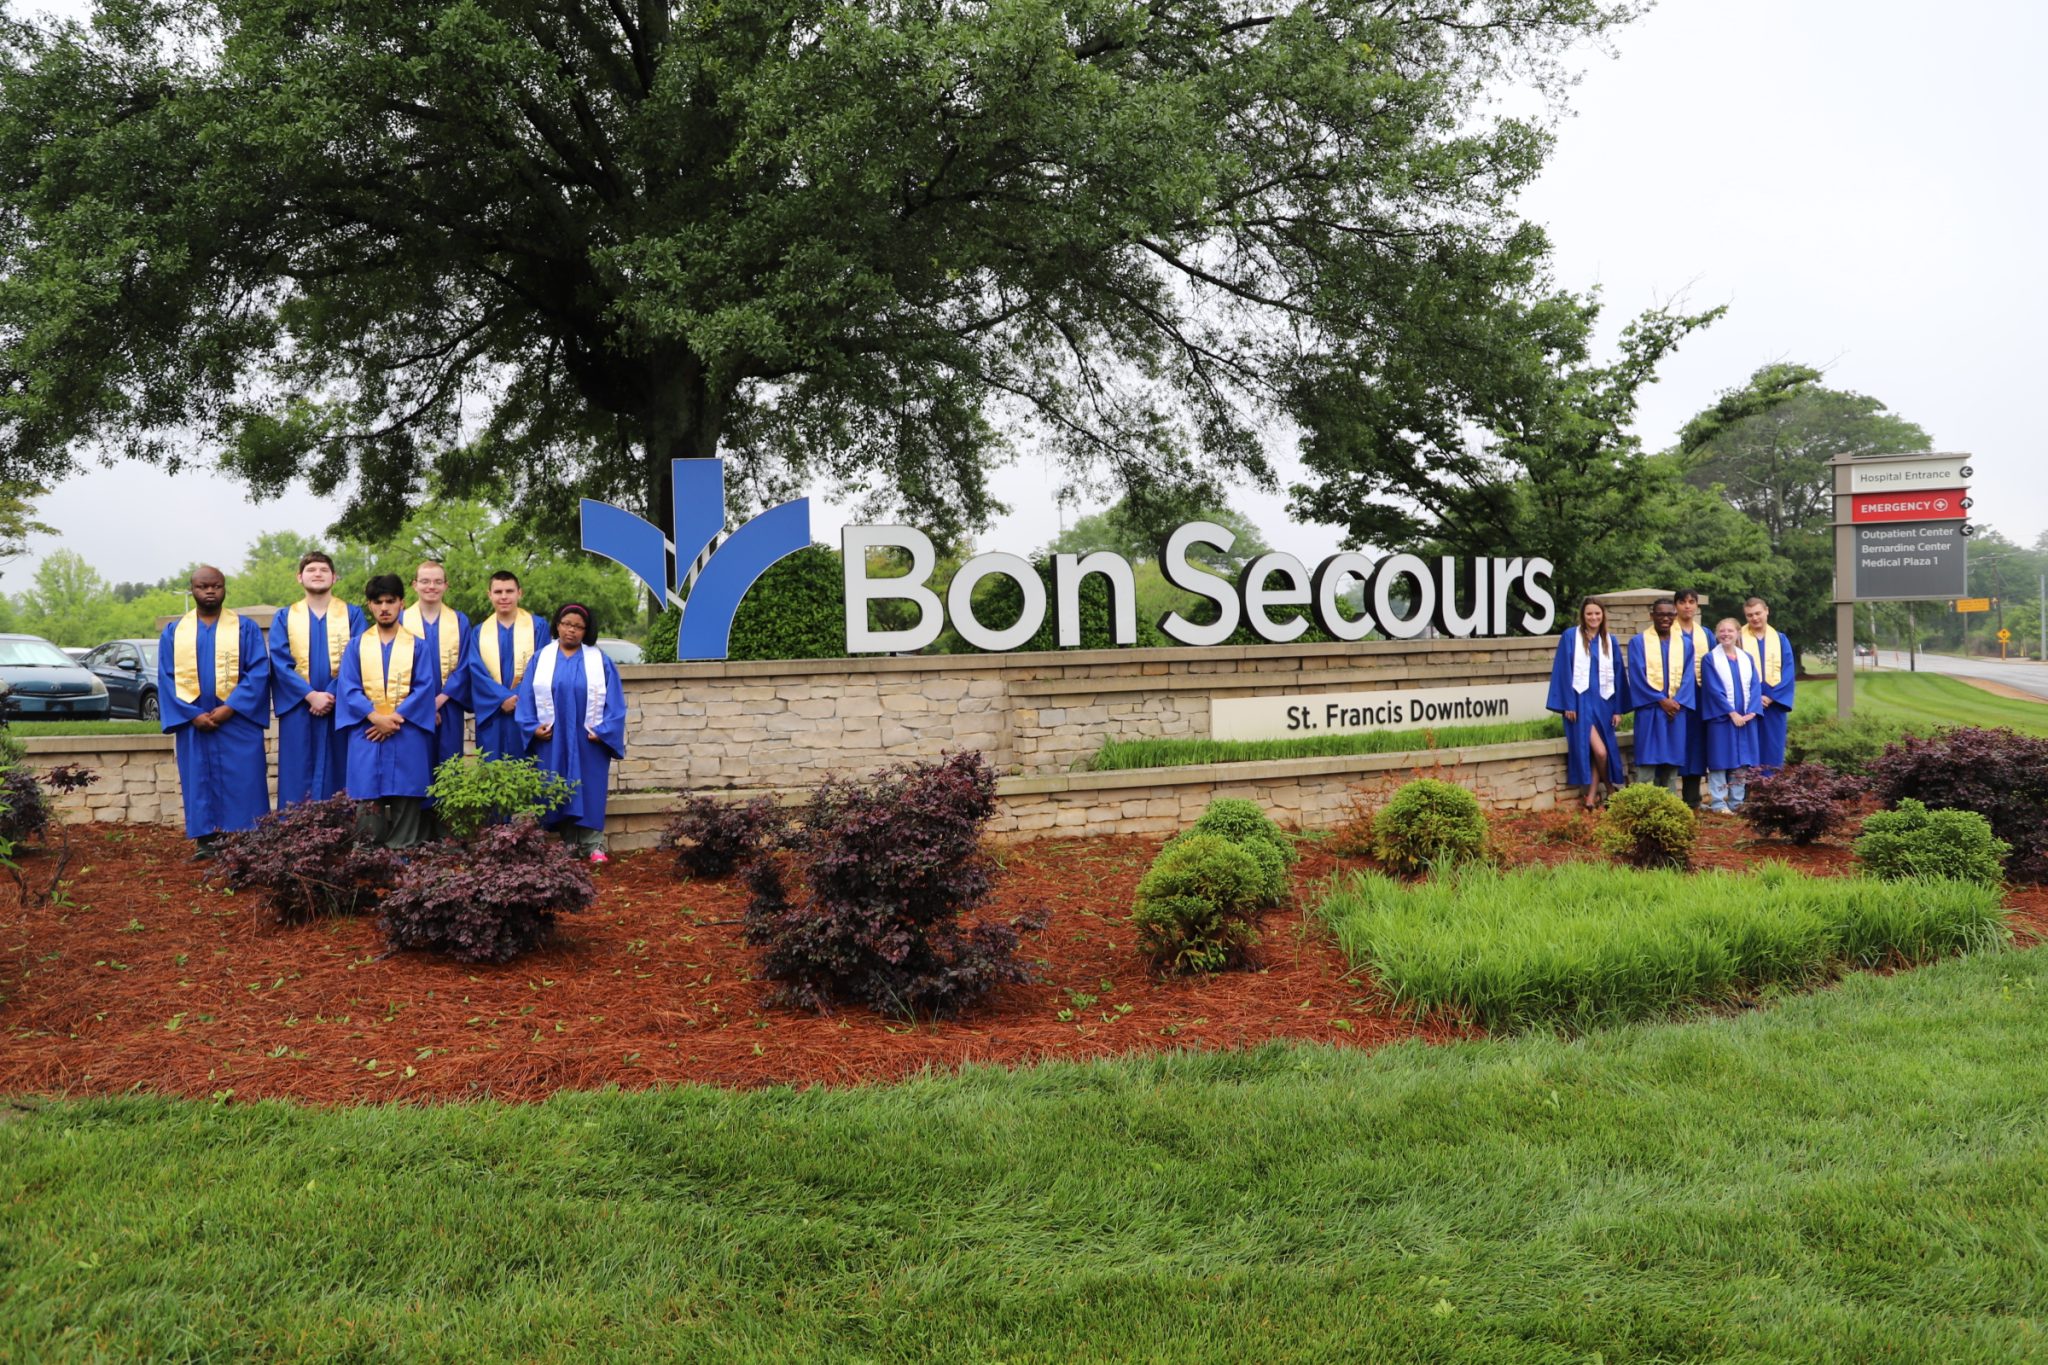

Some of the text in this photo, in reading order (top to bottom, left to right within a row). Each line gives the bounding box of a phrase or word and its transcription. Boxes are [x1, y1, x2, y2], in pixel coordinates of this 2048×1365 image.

[1860, 470, 1951, 483] Hospital Entrance
[1861, 501, 1931, 513] EMERGENCY
[1861, 528, 1954, 541] Outpatient Center
[1862, 542, 1951, 553] Bernardine Center
[1862, 558, 1901, 568] Medical
[1903, 557, 1931, 566] Plaza
[842, 521, 1555, 653] Bon Secours
[1287, 696, 1509, 731] St. Francis Downtown
